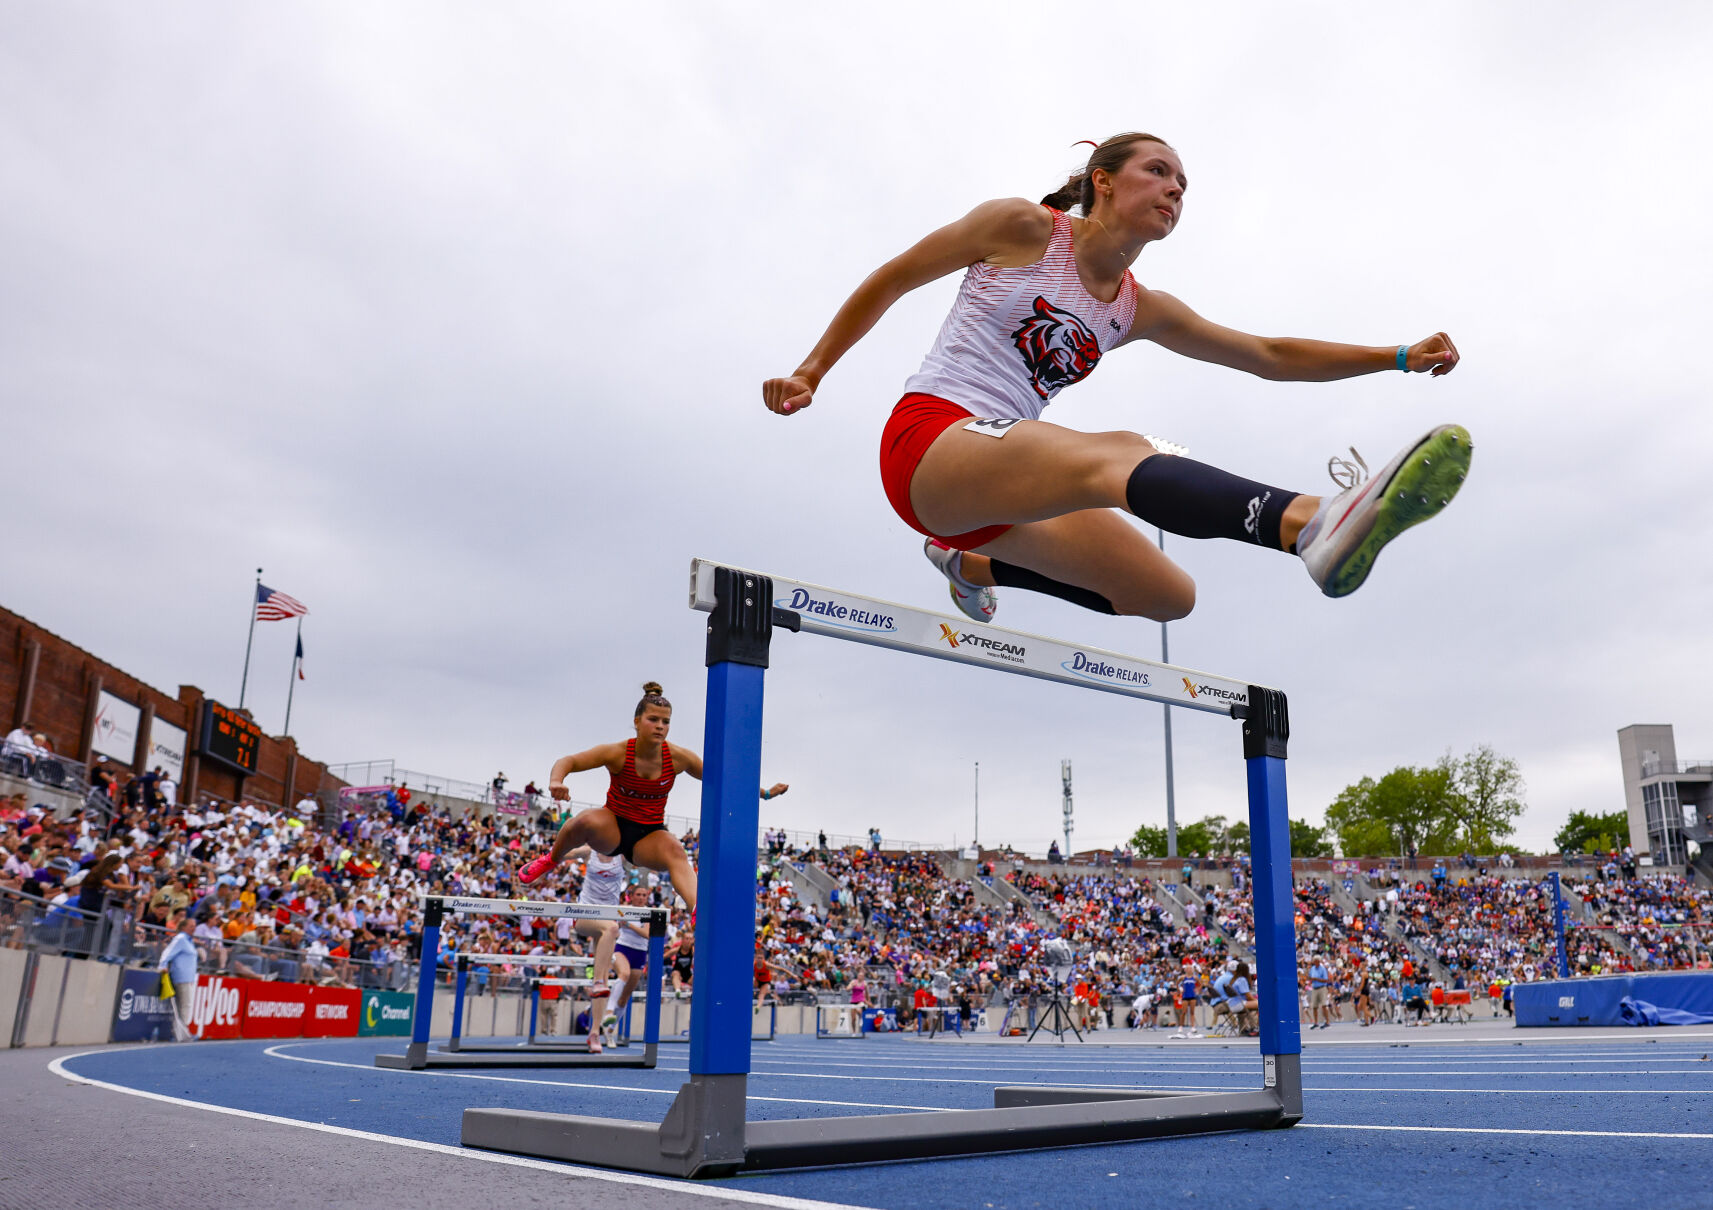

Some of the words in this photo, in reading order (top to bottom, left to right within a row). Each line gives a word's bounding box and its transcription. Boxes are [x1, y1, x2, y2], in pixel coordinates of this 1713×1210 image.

[789, 588, 848, 619] Drake
[849, 608, 895, 630] RELAYS
[960, 633, 1026, 657] XTREAM
[1072, 651, 1115, 678] Drake
[1116, 668, 1149, 685] RELAYS
[1198, 685, 1247, 703] XTREAM
[248, 1000, 305, 1018] CHAMPIONSHIP
[315, 1004, 349, 1020] NETWORK
[382, 1005, 410, 1020] Channel
[839, 1017, 846, 1026] 7
[979, 1017, 986, 1026] 6
